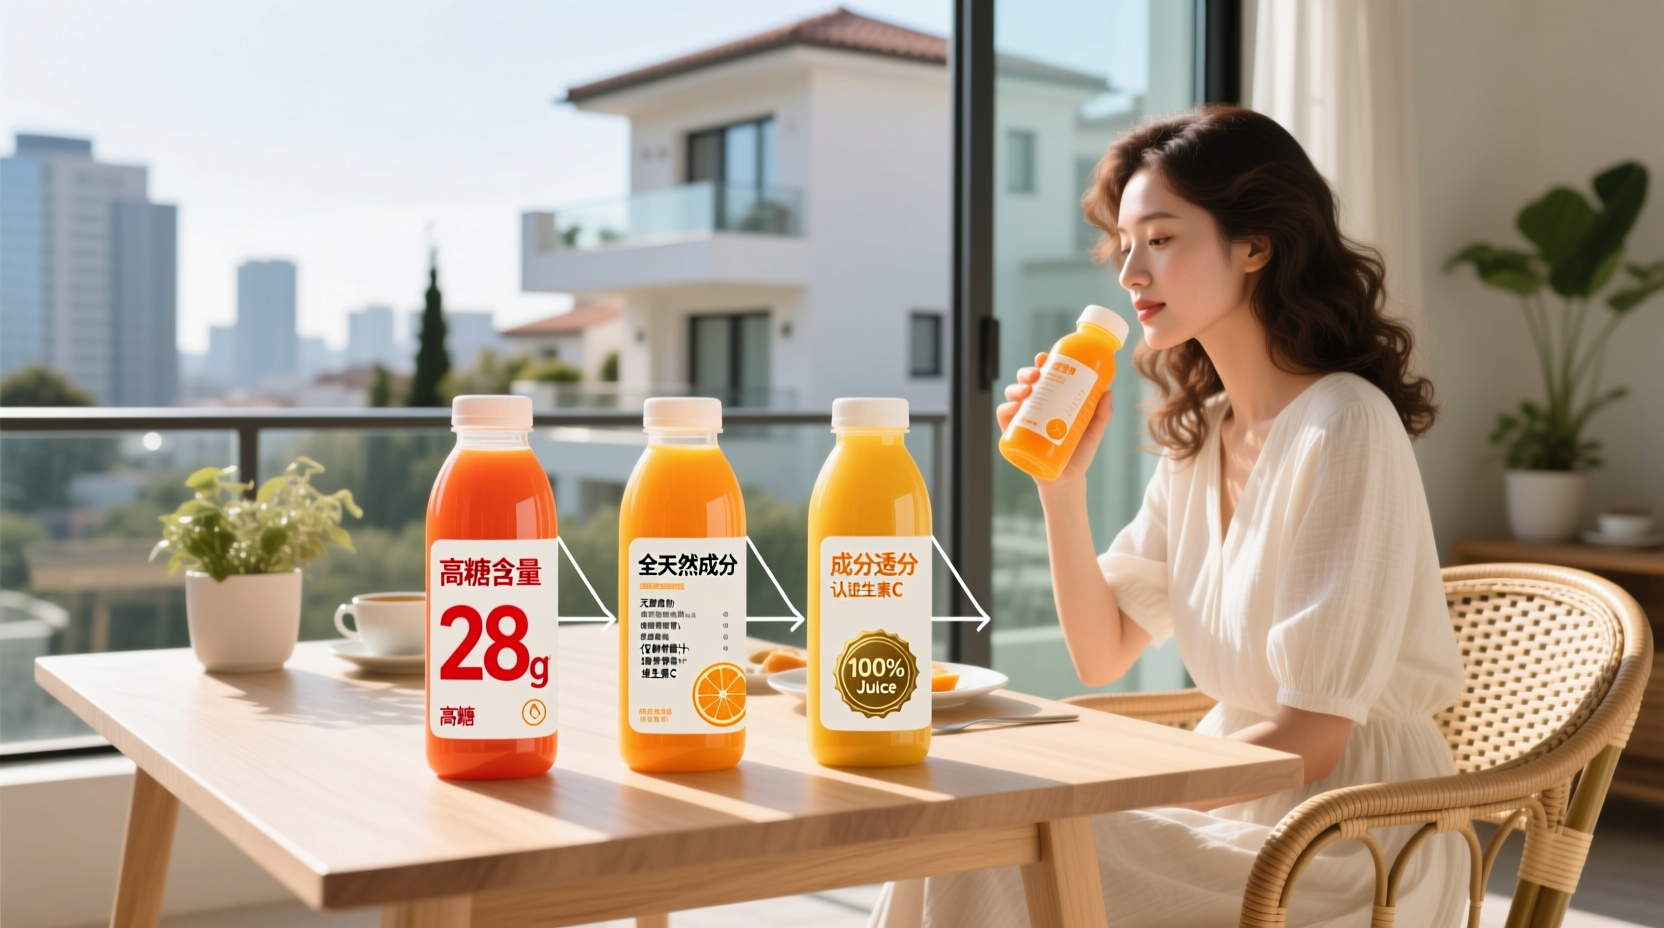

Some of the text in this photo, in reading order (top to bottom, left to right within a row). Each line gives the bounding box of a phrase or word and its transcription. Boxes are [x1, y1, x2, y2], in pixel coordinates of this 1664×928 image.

[440, 557, 542, 587] 高糖含量
[638, 553, 738, 576] 全天然成分
[848, 657, 905, 678] 100%
[856, 680, 897, 694] Juice
[440, 705, 475, 727] 高糖
